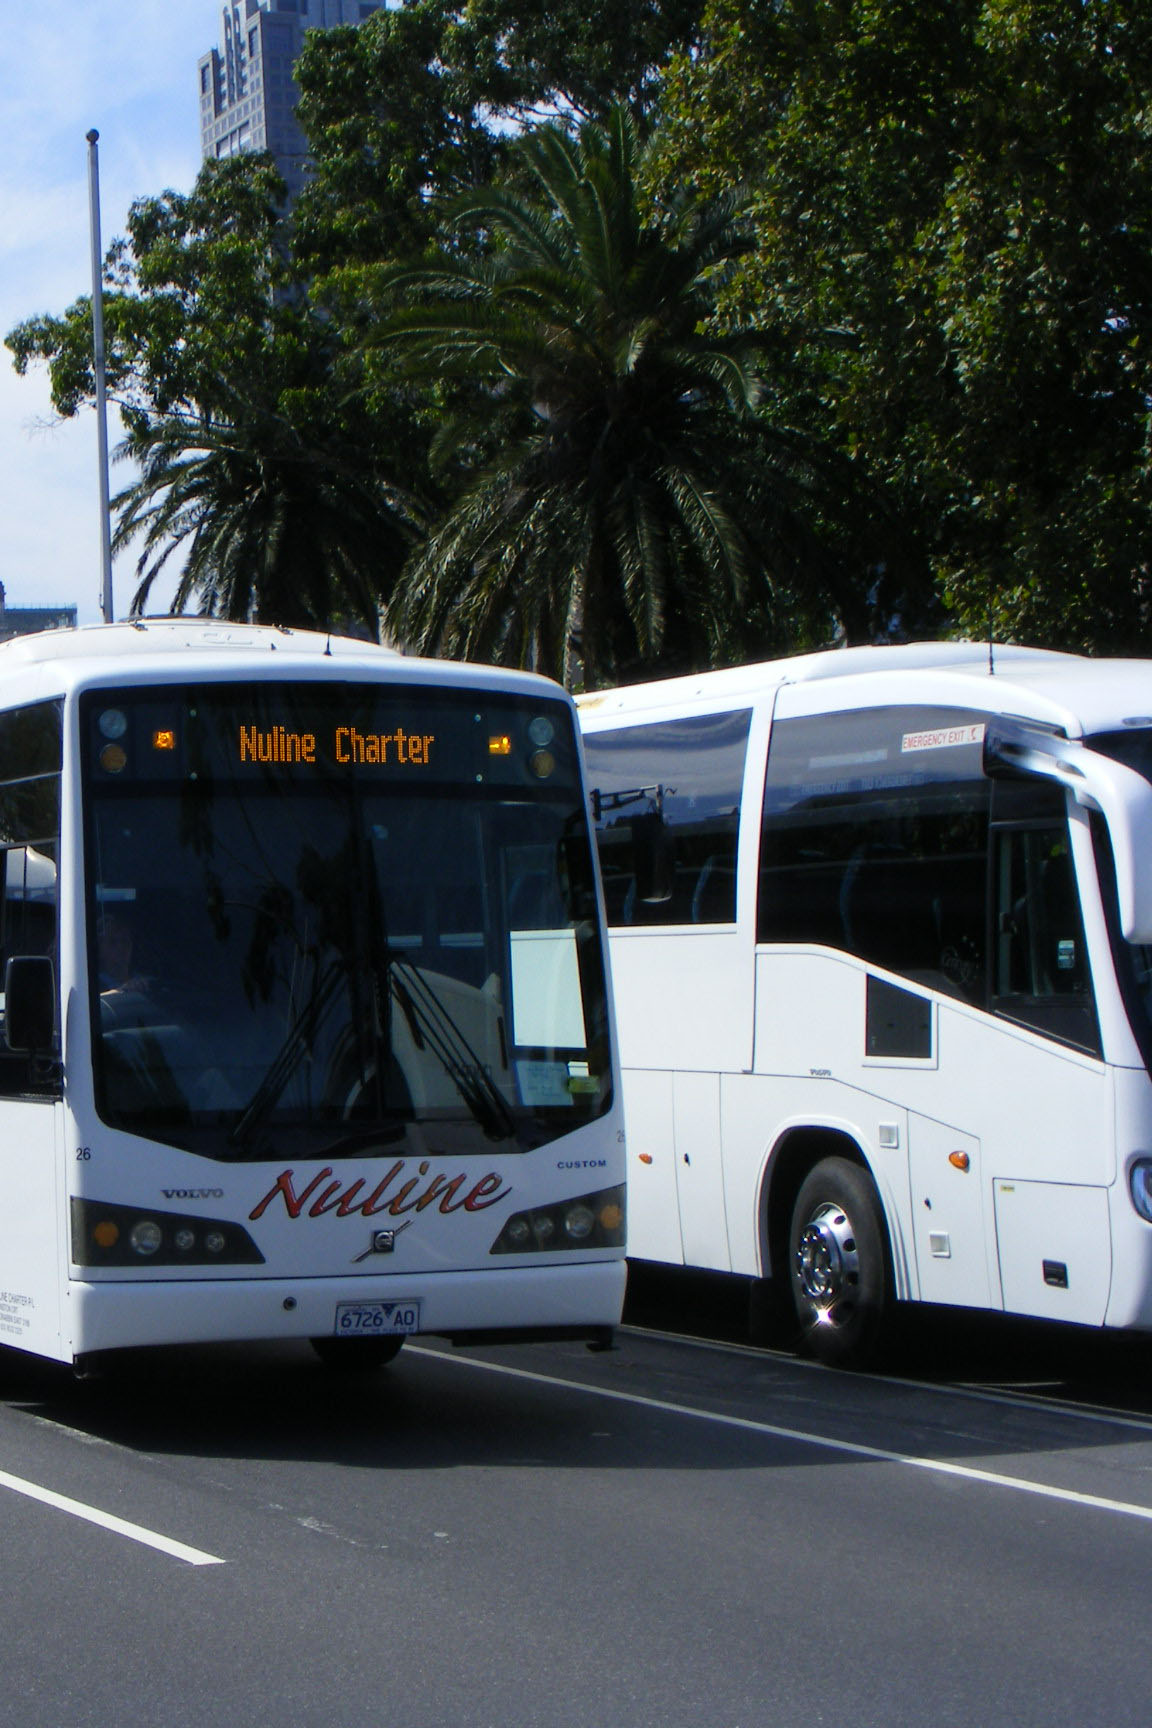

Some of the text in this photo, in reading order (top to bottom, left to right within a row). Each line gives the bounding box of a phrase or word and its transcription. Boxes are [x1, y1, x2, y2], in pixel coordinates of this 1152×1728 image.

[240, 726, 435, 763] Nuline Charter
[903, 730, 966, 749] EMERGENCY EXIT
[76, 1147, 91, 1161] 26
[557, 1160, 607, 1169] CUSTOM
[161, 1188, 224, 1199] VOLVO
[249, 1160, 513, 1220] Nuline
[341, 1311, 384, 1329] 6726
